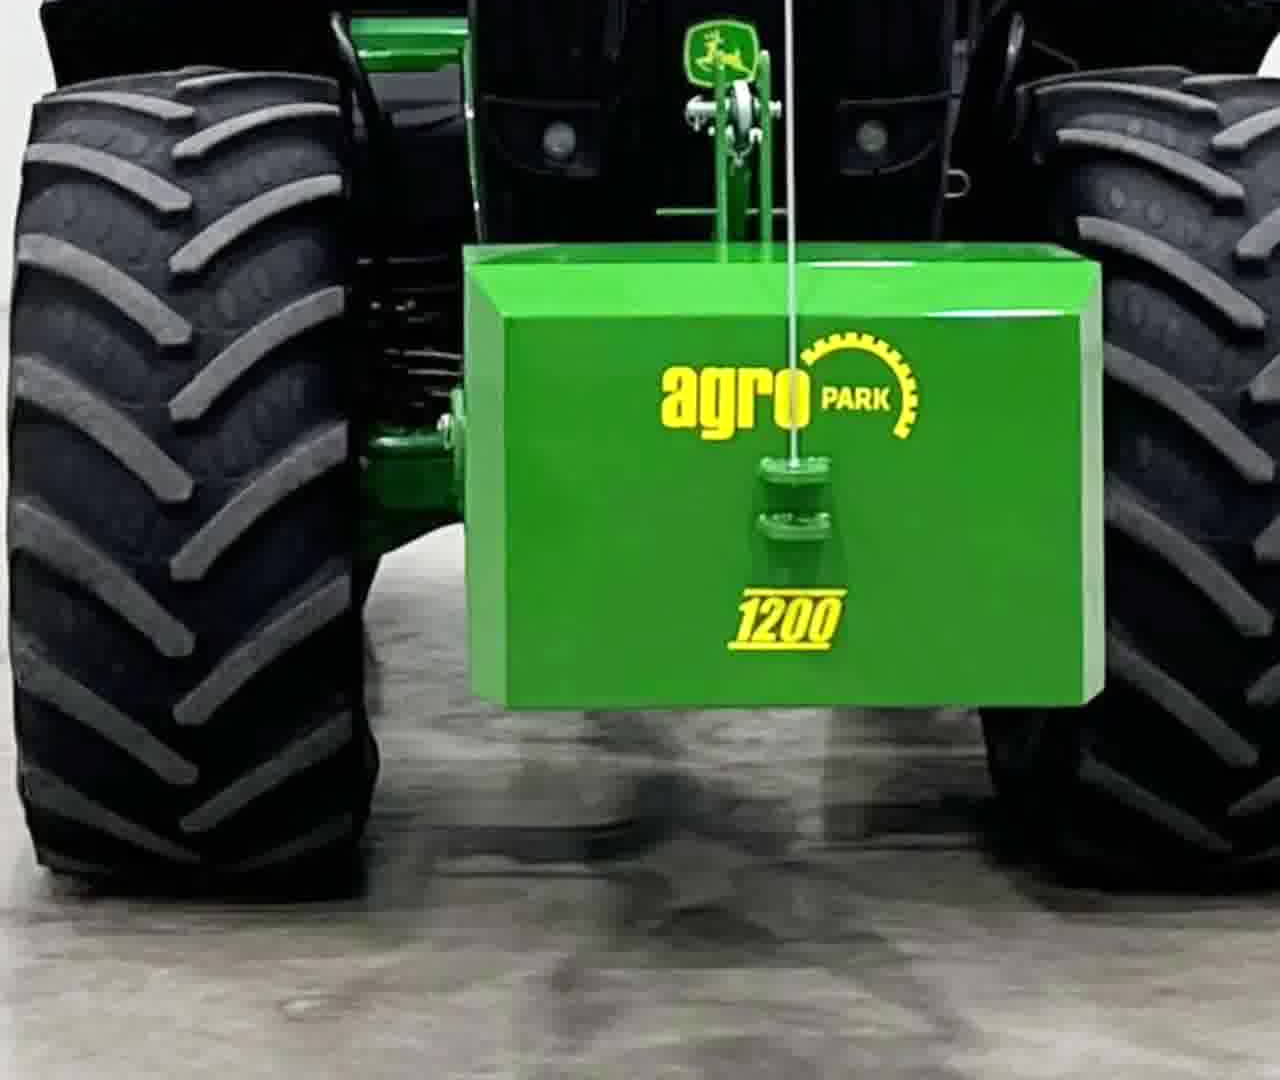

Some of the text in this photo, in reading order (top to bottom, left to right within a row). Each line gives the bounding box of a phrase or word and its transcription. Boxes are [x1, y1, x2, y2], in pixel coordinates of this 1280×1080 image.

[661, 366, 890, 441] agro PARK
[736, 596, 844, 642] 1200
